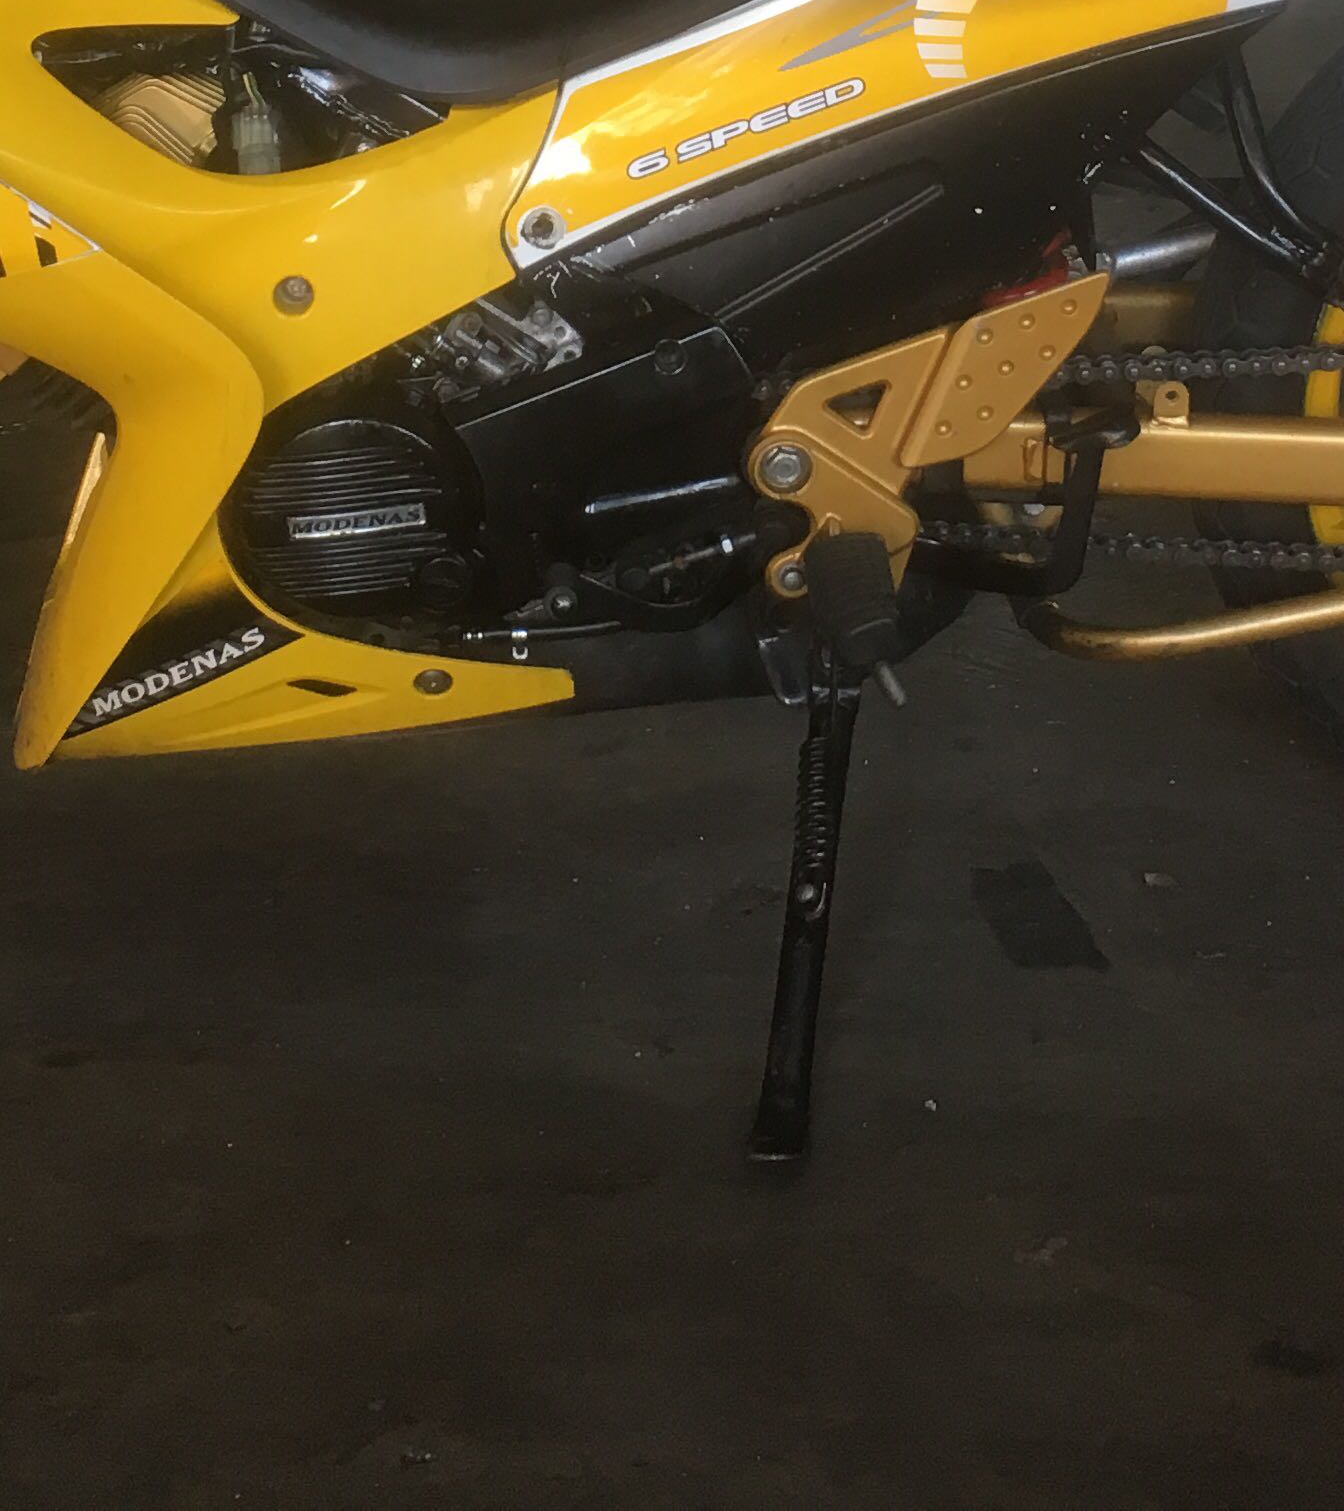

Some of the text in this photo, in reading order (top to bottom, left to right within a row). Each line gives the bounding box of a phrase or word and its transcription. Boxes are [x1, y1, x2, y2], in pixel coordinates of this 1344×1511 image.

[626, 77, 866, 179] 6 SPEED
[292, 506, 421, 534] MODENAS
[92, 627, 265, 717] MODENAS
